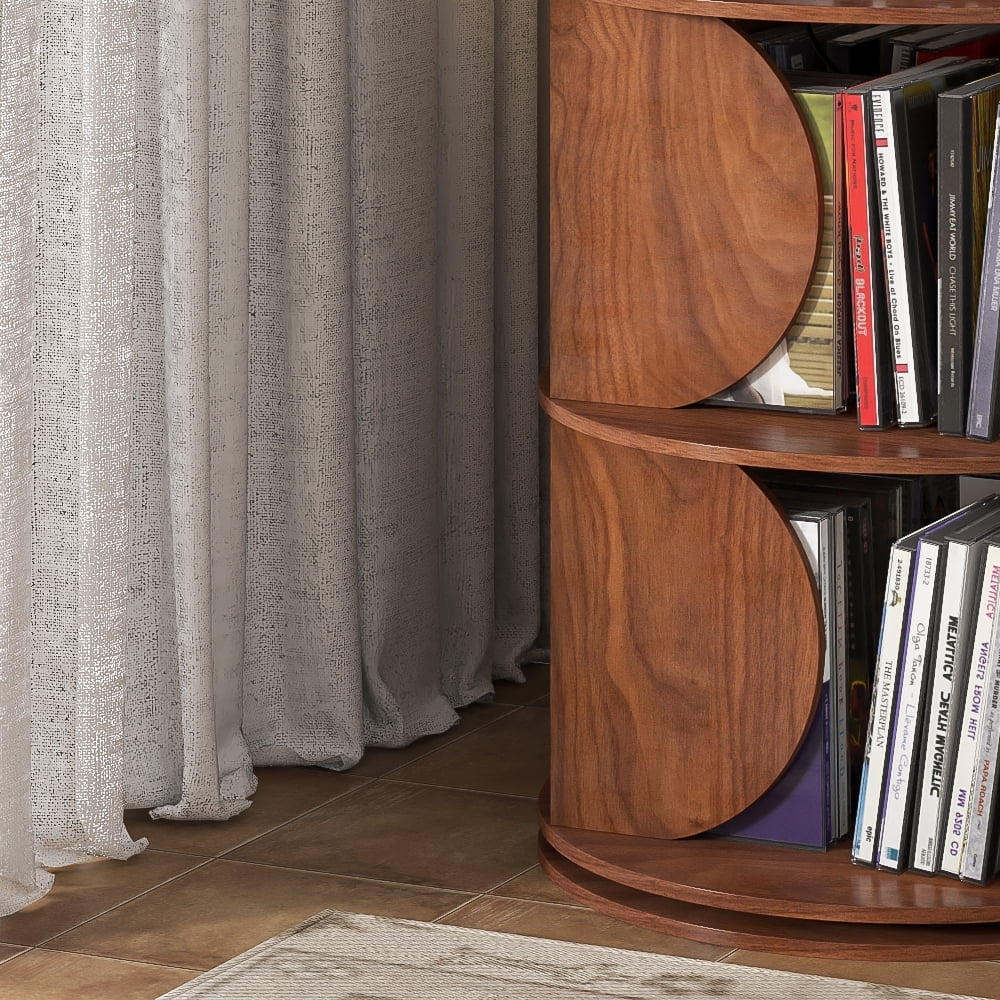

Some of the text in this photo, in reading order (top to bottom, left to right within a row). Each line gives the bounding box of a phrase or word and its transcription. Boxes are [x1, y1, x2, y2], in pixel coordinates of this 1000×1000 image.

[878, 153, 887, 187] HOWARD
[883, 213, 891, 236] WHITE
[888, 269, 896, 286] Live
[993, 269, 1000, 285] UNA
[890, 287, 897, 295] at
[990, 286, 1000, 312] MUJER
[856, 278, 867, 336] BLACKOUT
[891, 298, 900, 322] Chord
[894, 325, 901, 336] On
[922, 557, 933, 585] 18733-2
[912, 623, 925, 650] Olga
[884, 661, 893, 680] THE
[991, 679, 1000, 709] MURDER
[876, 681, 890, 748] MASTERPLAN
[892, 754, 908, 800] Contigo
[981, 759, 990, 782] PAPA
[977, 784, 987, 817] ROACH
[865, 826, 874, 842] epic
